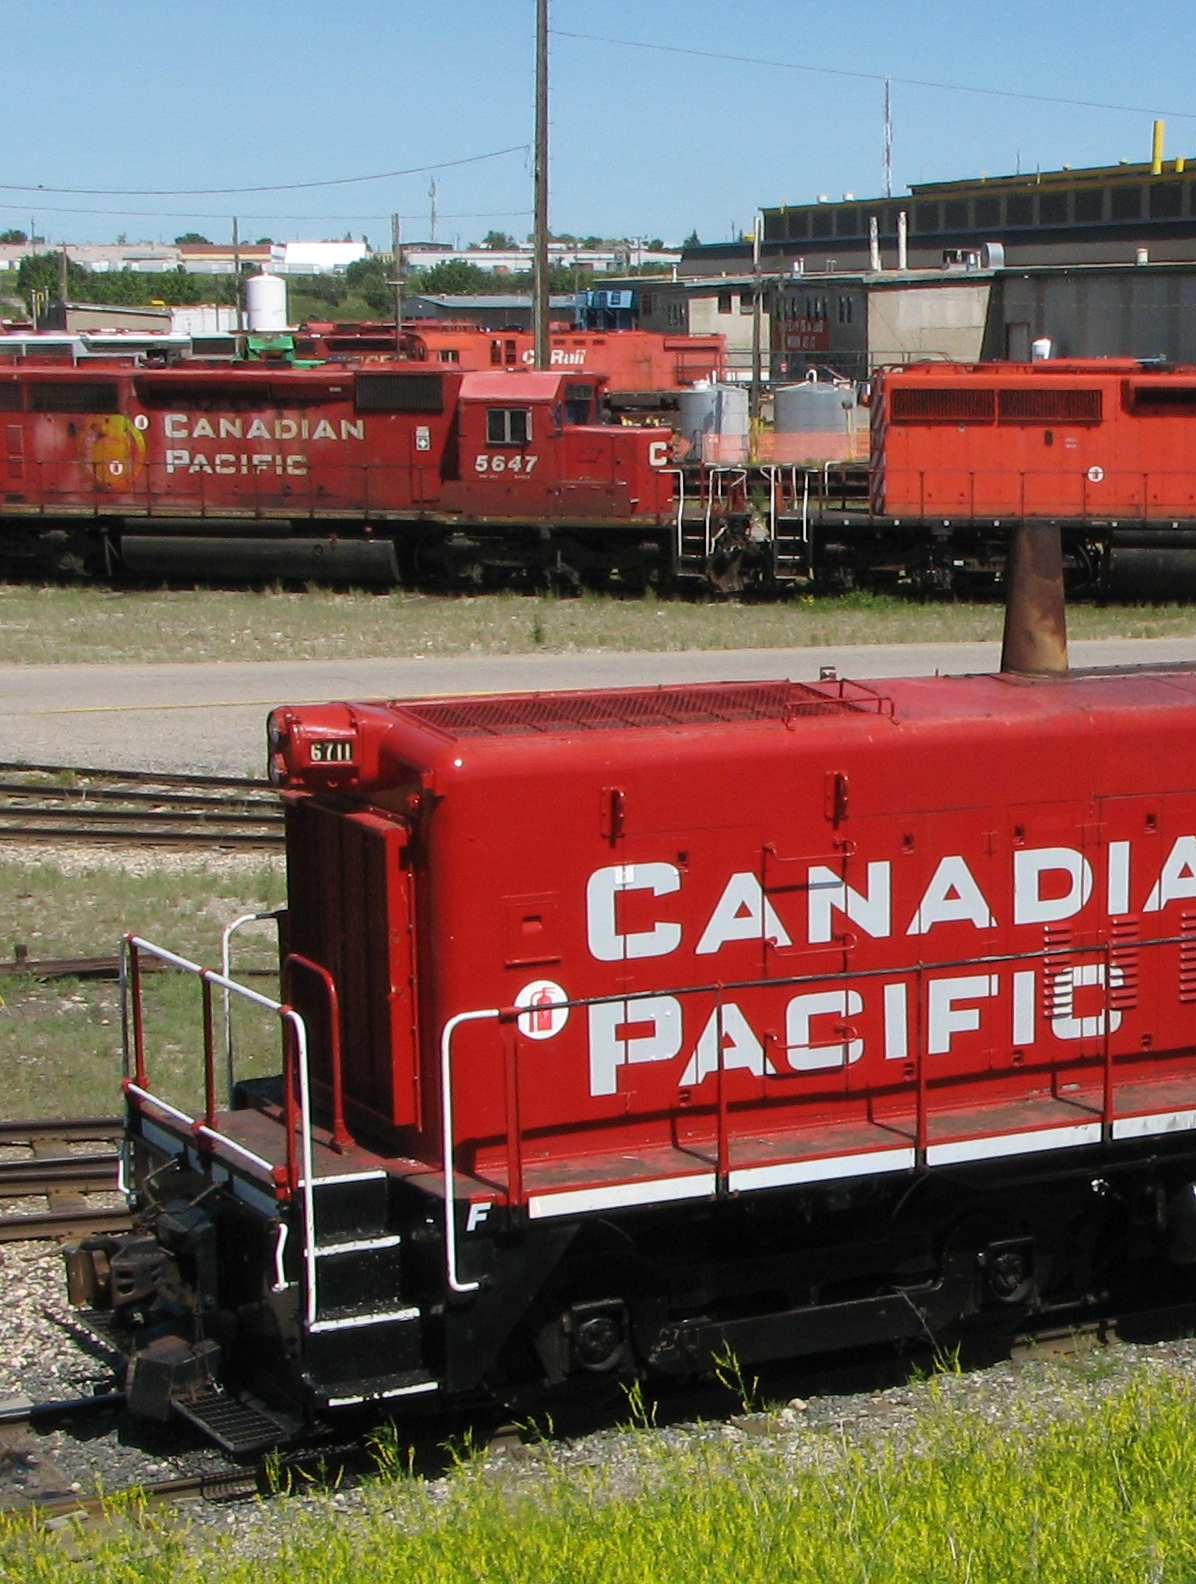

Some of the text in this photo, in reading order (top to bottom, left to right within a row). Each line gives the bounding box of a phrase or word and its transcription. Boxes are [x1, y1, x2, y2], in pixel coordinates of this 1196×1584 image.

[550, 349, 587, 365] Rail
[163, 413, 366, 441] CANADIAN
[165, 449, 308, 476] PACIFIC
[474, 454, 539, 473] 5647
[309, 743, 352, 762] 6711
[587, 963, 1125, 1098] PACIFIC
[465, 1201, 493, 1233] F
